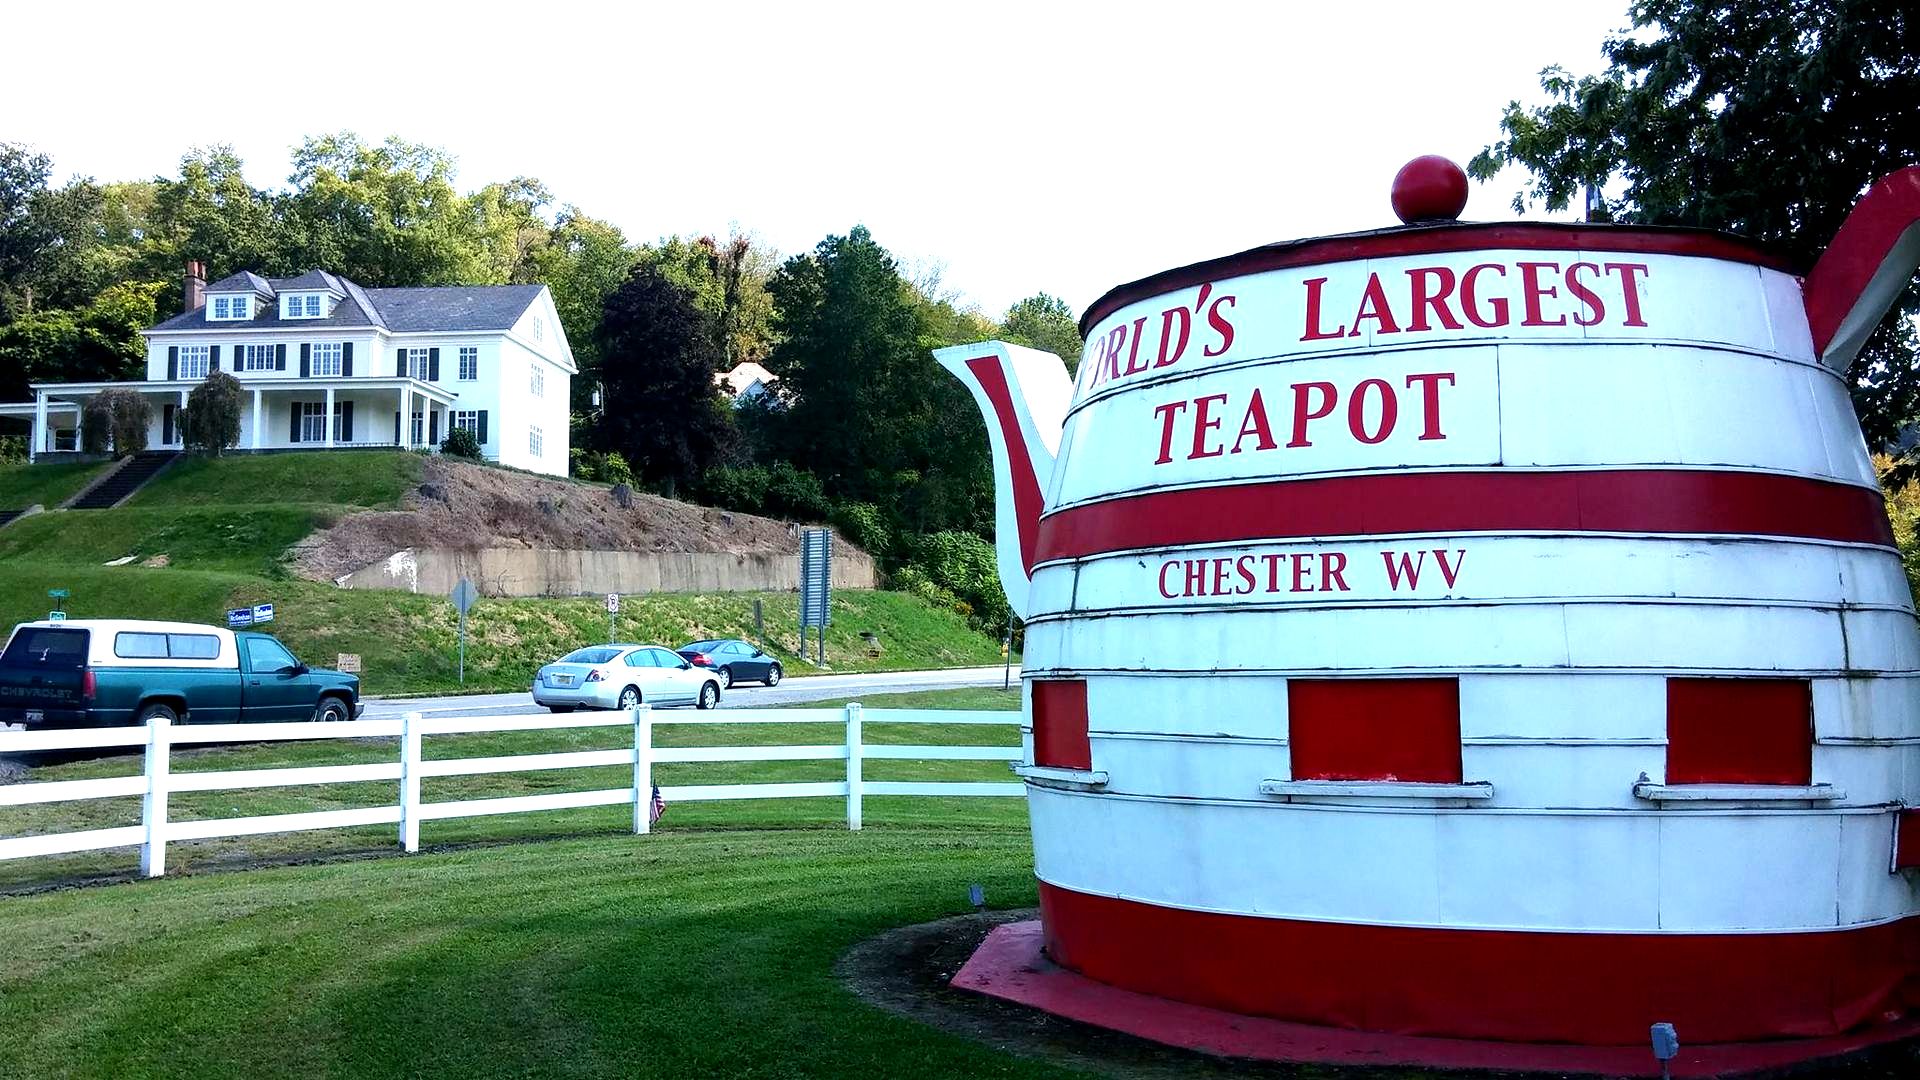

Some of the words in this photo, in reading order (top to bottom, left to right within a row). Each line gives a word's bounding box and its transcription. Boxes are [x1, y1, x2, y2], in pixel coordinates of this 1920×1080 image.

[1086, 282, 1236, 391] ORLD'S
[1299, 262, 1650, 342] LARGEST
[1154, 372, 1456, 466] TEAPOT
[1158, 552, 1349, 599] CHESTER
[1380, 549, 1466, 590] WV
[0, 686, 73, 699] CHEVROLET
